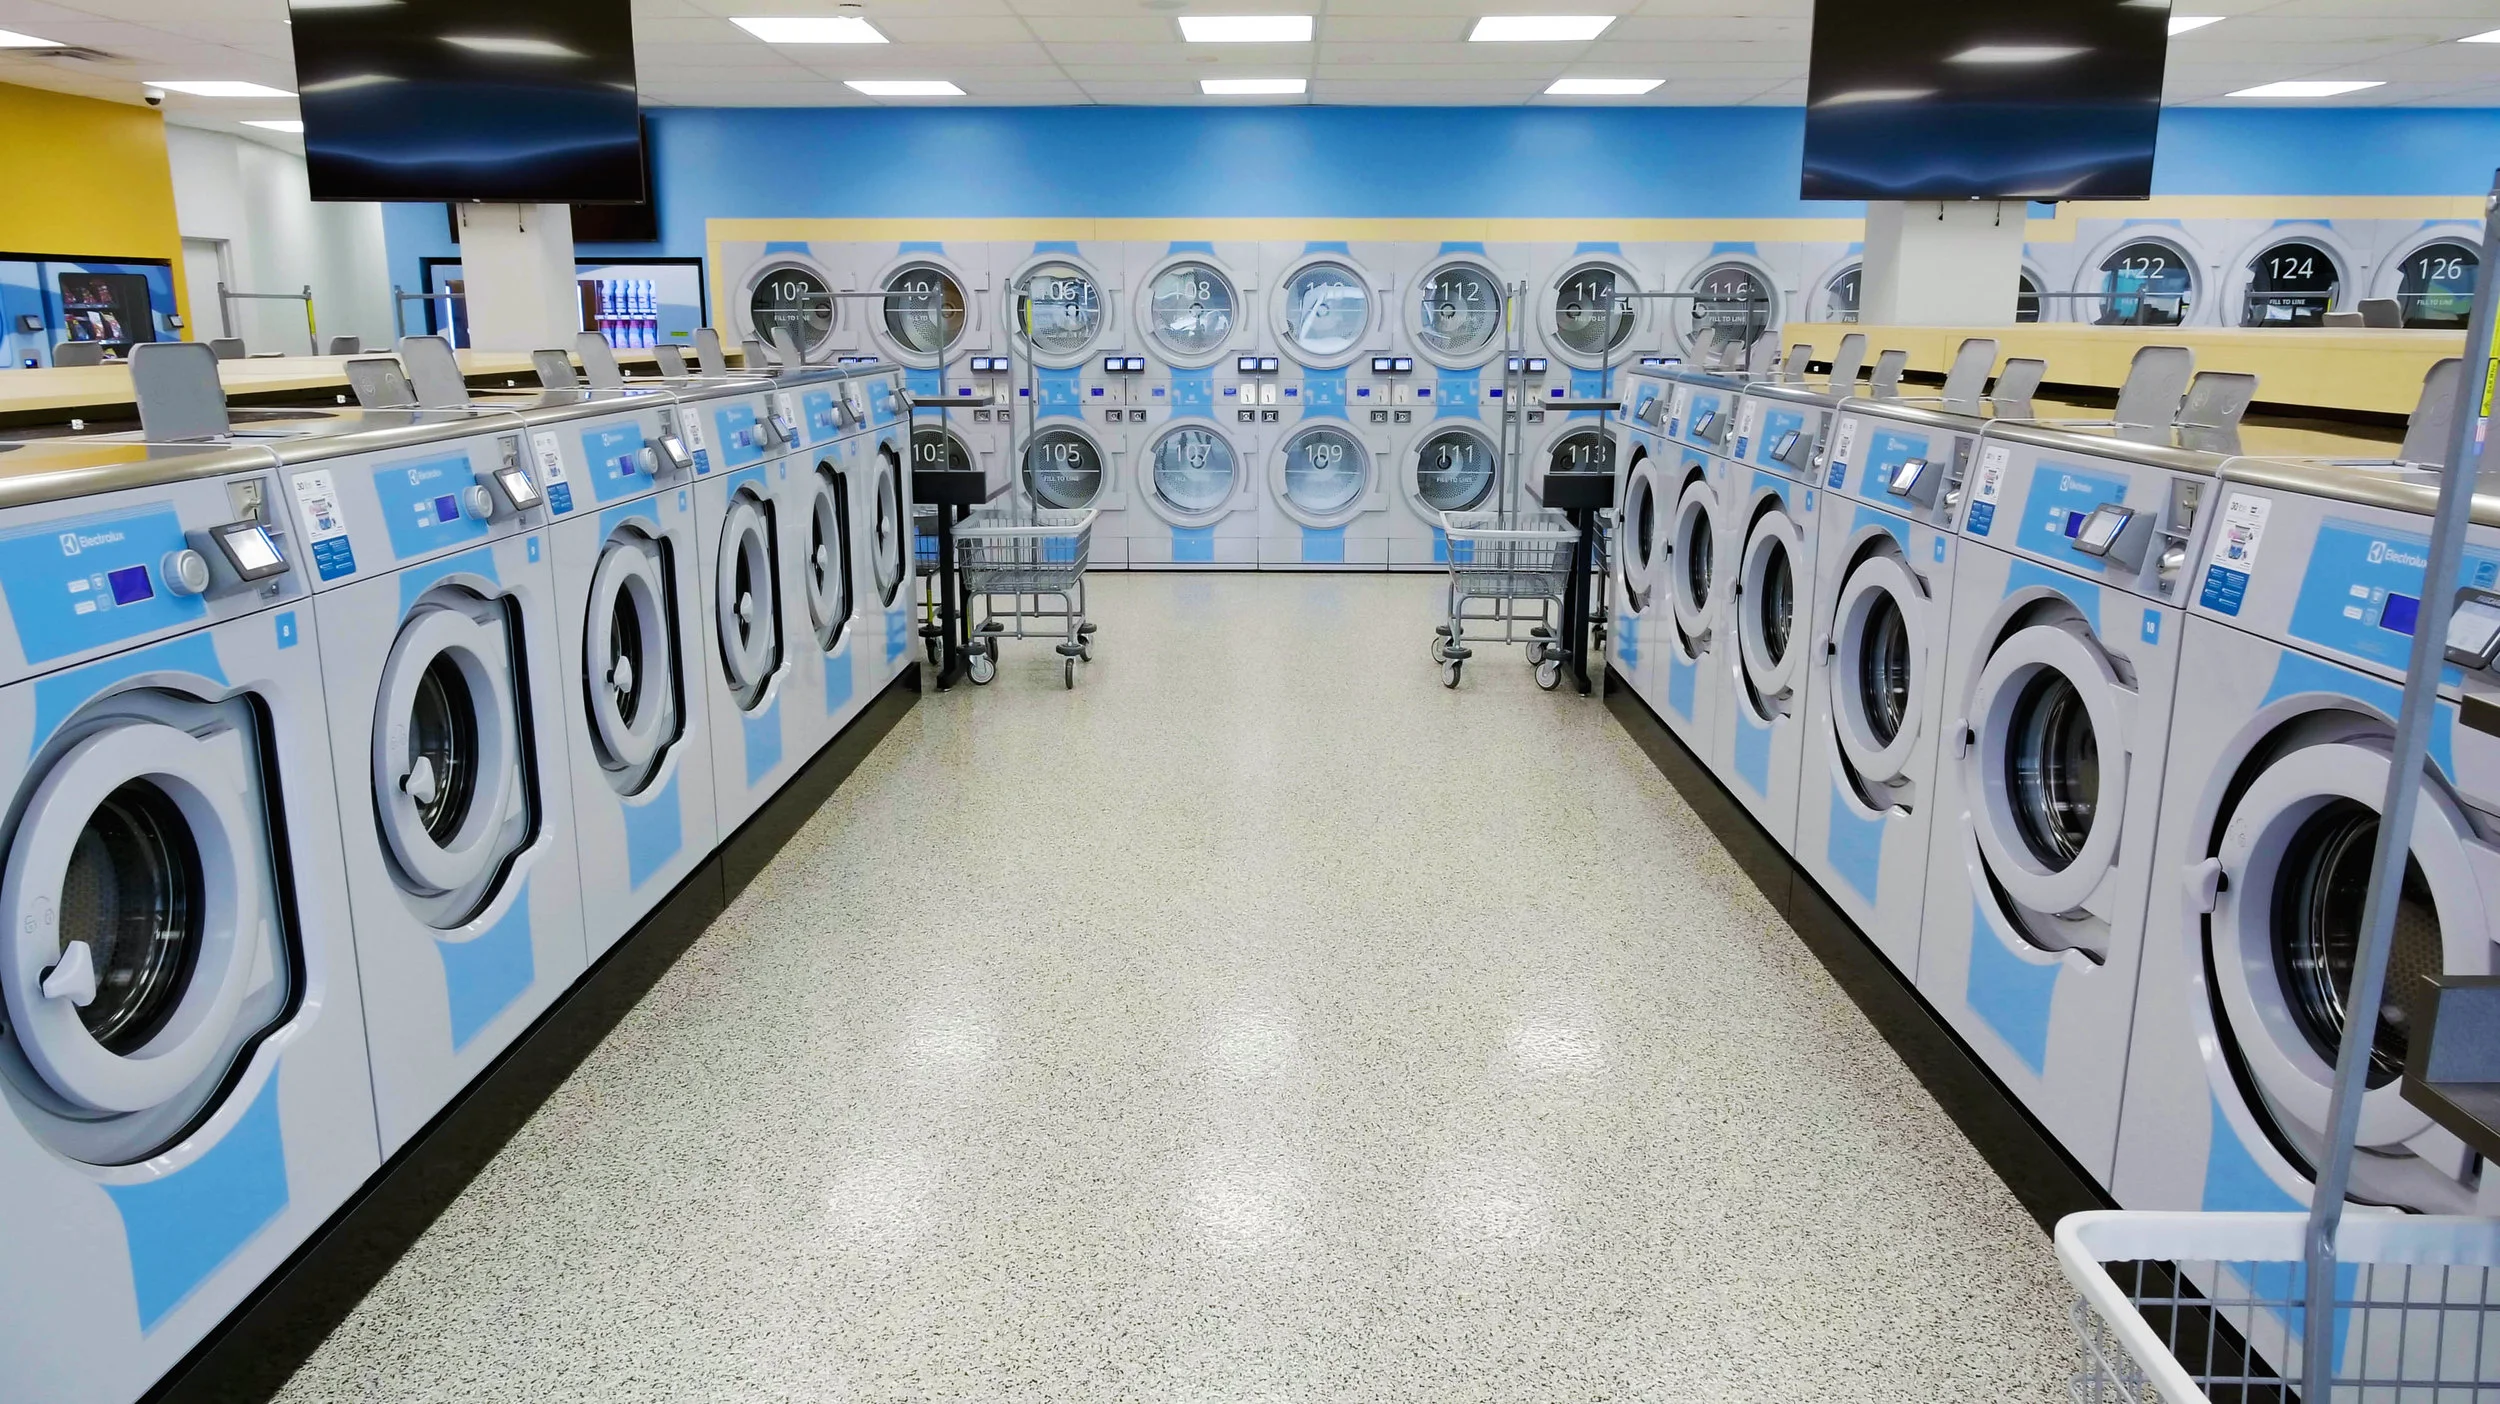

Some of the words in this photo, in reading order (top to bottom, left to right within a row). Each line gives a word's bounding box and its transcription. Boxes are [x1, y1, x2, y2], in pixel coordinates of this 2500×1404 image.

[2122, 257, 2165, 279] 122
[2270, 257, 2314, 279] 124
[2419, 257, 2463, 280] 126
[771, 281, 810, 301] 102
[904, 281, 943, 301] 10
[1171, 281, 1211, 300] 108
[1441, 281, 1480, 301] 112
[1710, 282, 1748, 301] 116
[913, 443, 944, 462] 103
[1042, 443, 1080, 462] 105
[1175, 444, 1212, 463] 107
[1305, 444, 1343, 463] 109
[1438, 444, 1474, 463] 111
[1568, 444, 1607, 463] 113
[79, 531, 125, 548] Electrolux
[283, 625, 290, 637] 8
[2146, 621, 2156, 634] 18
